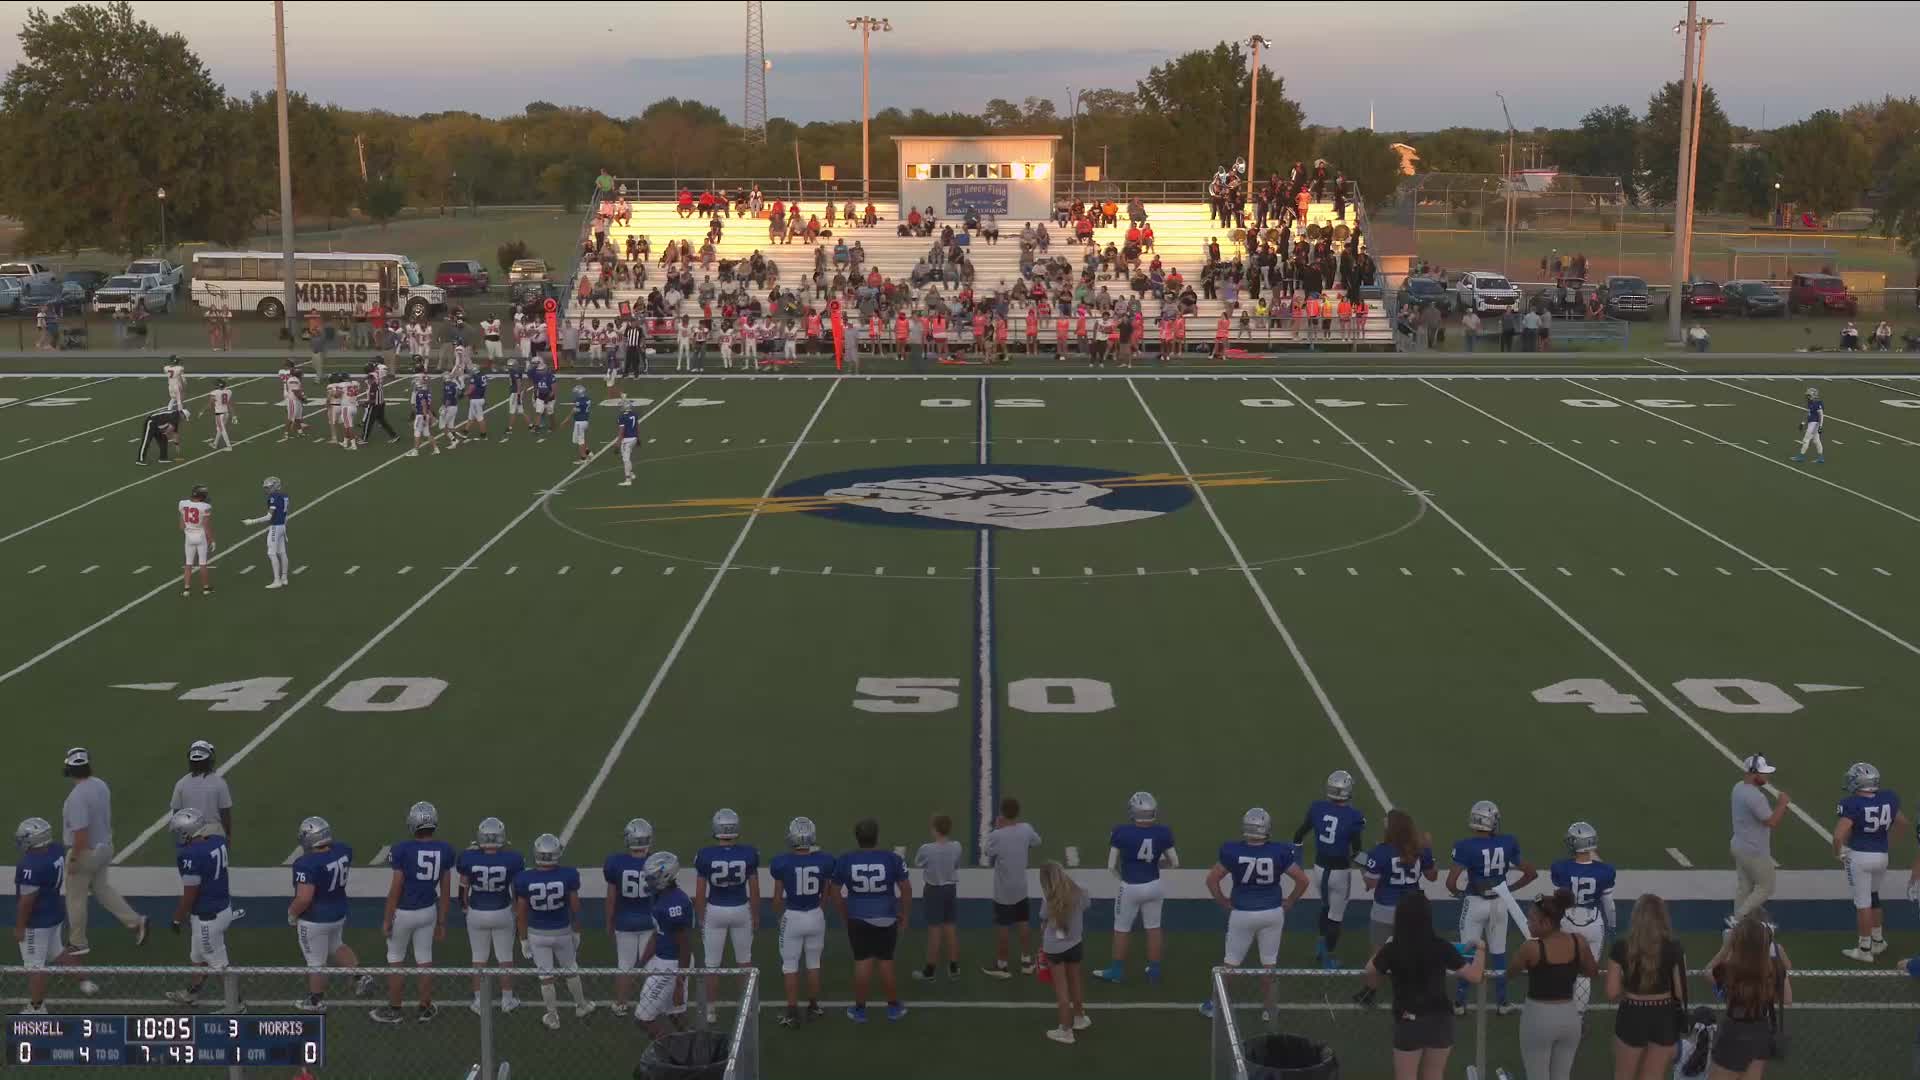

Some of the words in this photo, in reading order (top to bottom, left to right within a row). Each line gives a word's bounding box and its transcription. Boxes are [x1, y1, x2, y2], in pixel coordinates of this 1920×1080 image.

[294, 282, 369, 303] MORRIS
[183, 506, 200, 524] 13
[1319, 814, 1338, 844] 3
[1864, 803, 1892, 833] 54
[1136, 838, 1153, 863] 4
[1482, 847, 1505, 878] 14
[23, 869, 31, 880] 71
[296, 871, 305, 883] 76
[326, 855, 349, 892] 76
[416, 850, 441, 881] 51
[471, 866, 507, 892] 32
[711, 860, 747, 888] 23
[851, 863, 888, 893] 52
[1238, 856, 1274, 885] 79
[1391, 856, 1420, 885] 53
[795, 866, 820, 896] 16
[1570, 876, 1597, 905] 12
[528, 881, 564, 911] 22
[668, 905, 683, 918] 88
